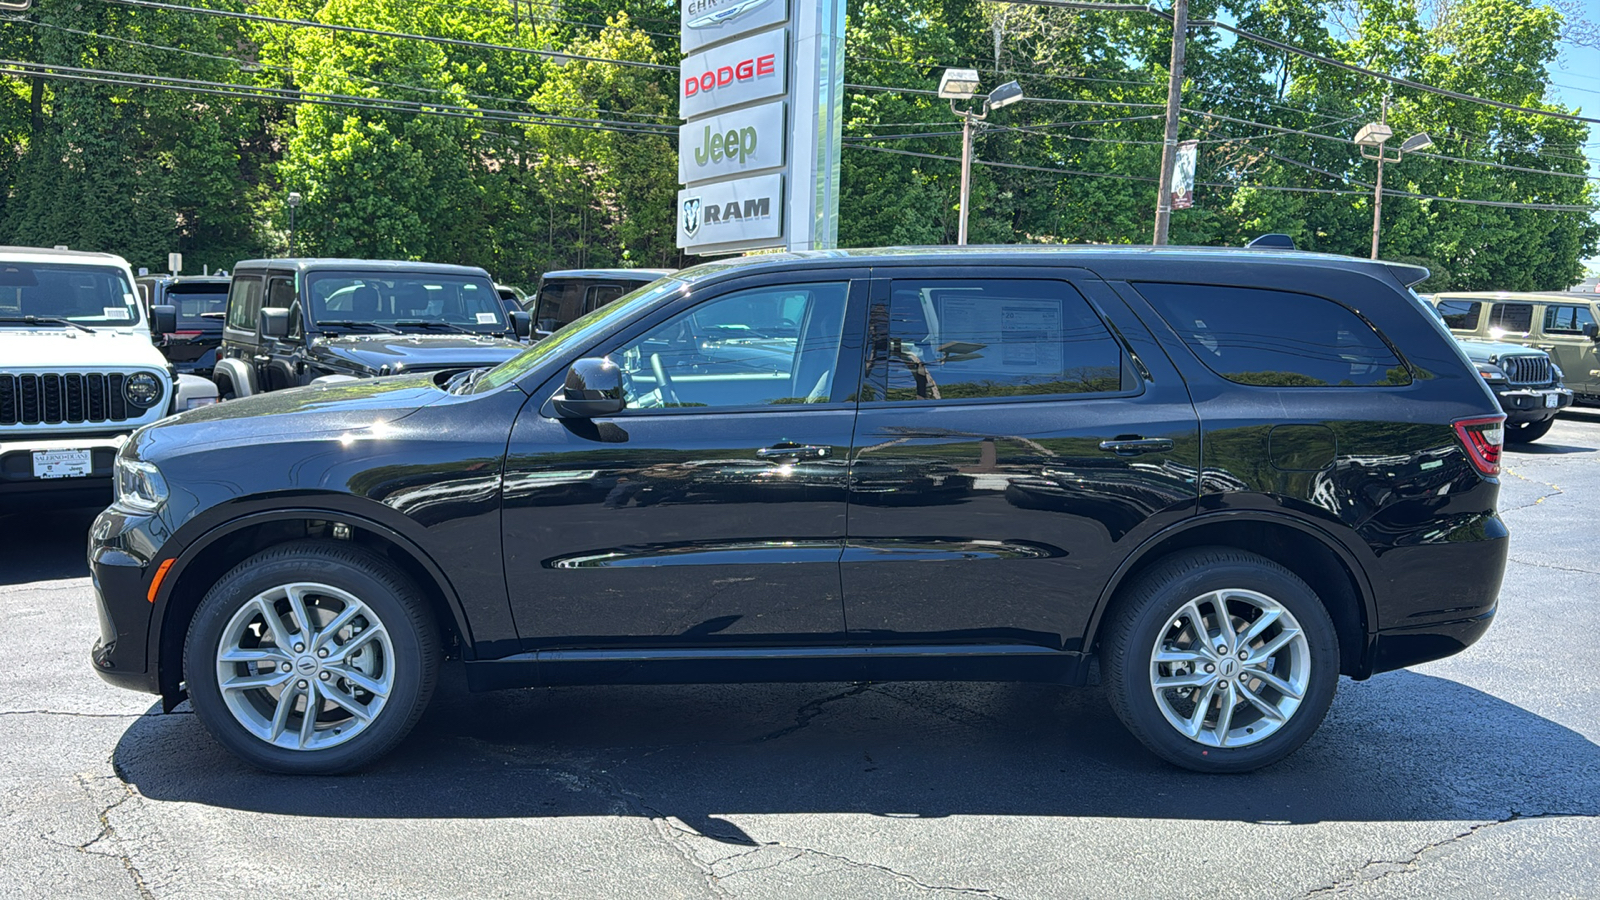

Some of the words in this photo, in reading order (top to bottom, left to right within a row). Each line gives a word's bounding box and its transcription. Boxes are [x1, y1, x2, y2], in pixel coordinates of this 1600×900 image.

[684, 53, 775, 97] DODGE
[695, 125, 757, 164] Jeep
[704, 197, 770, 223] RAM
